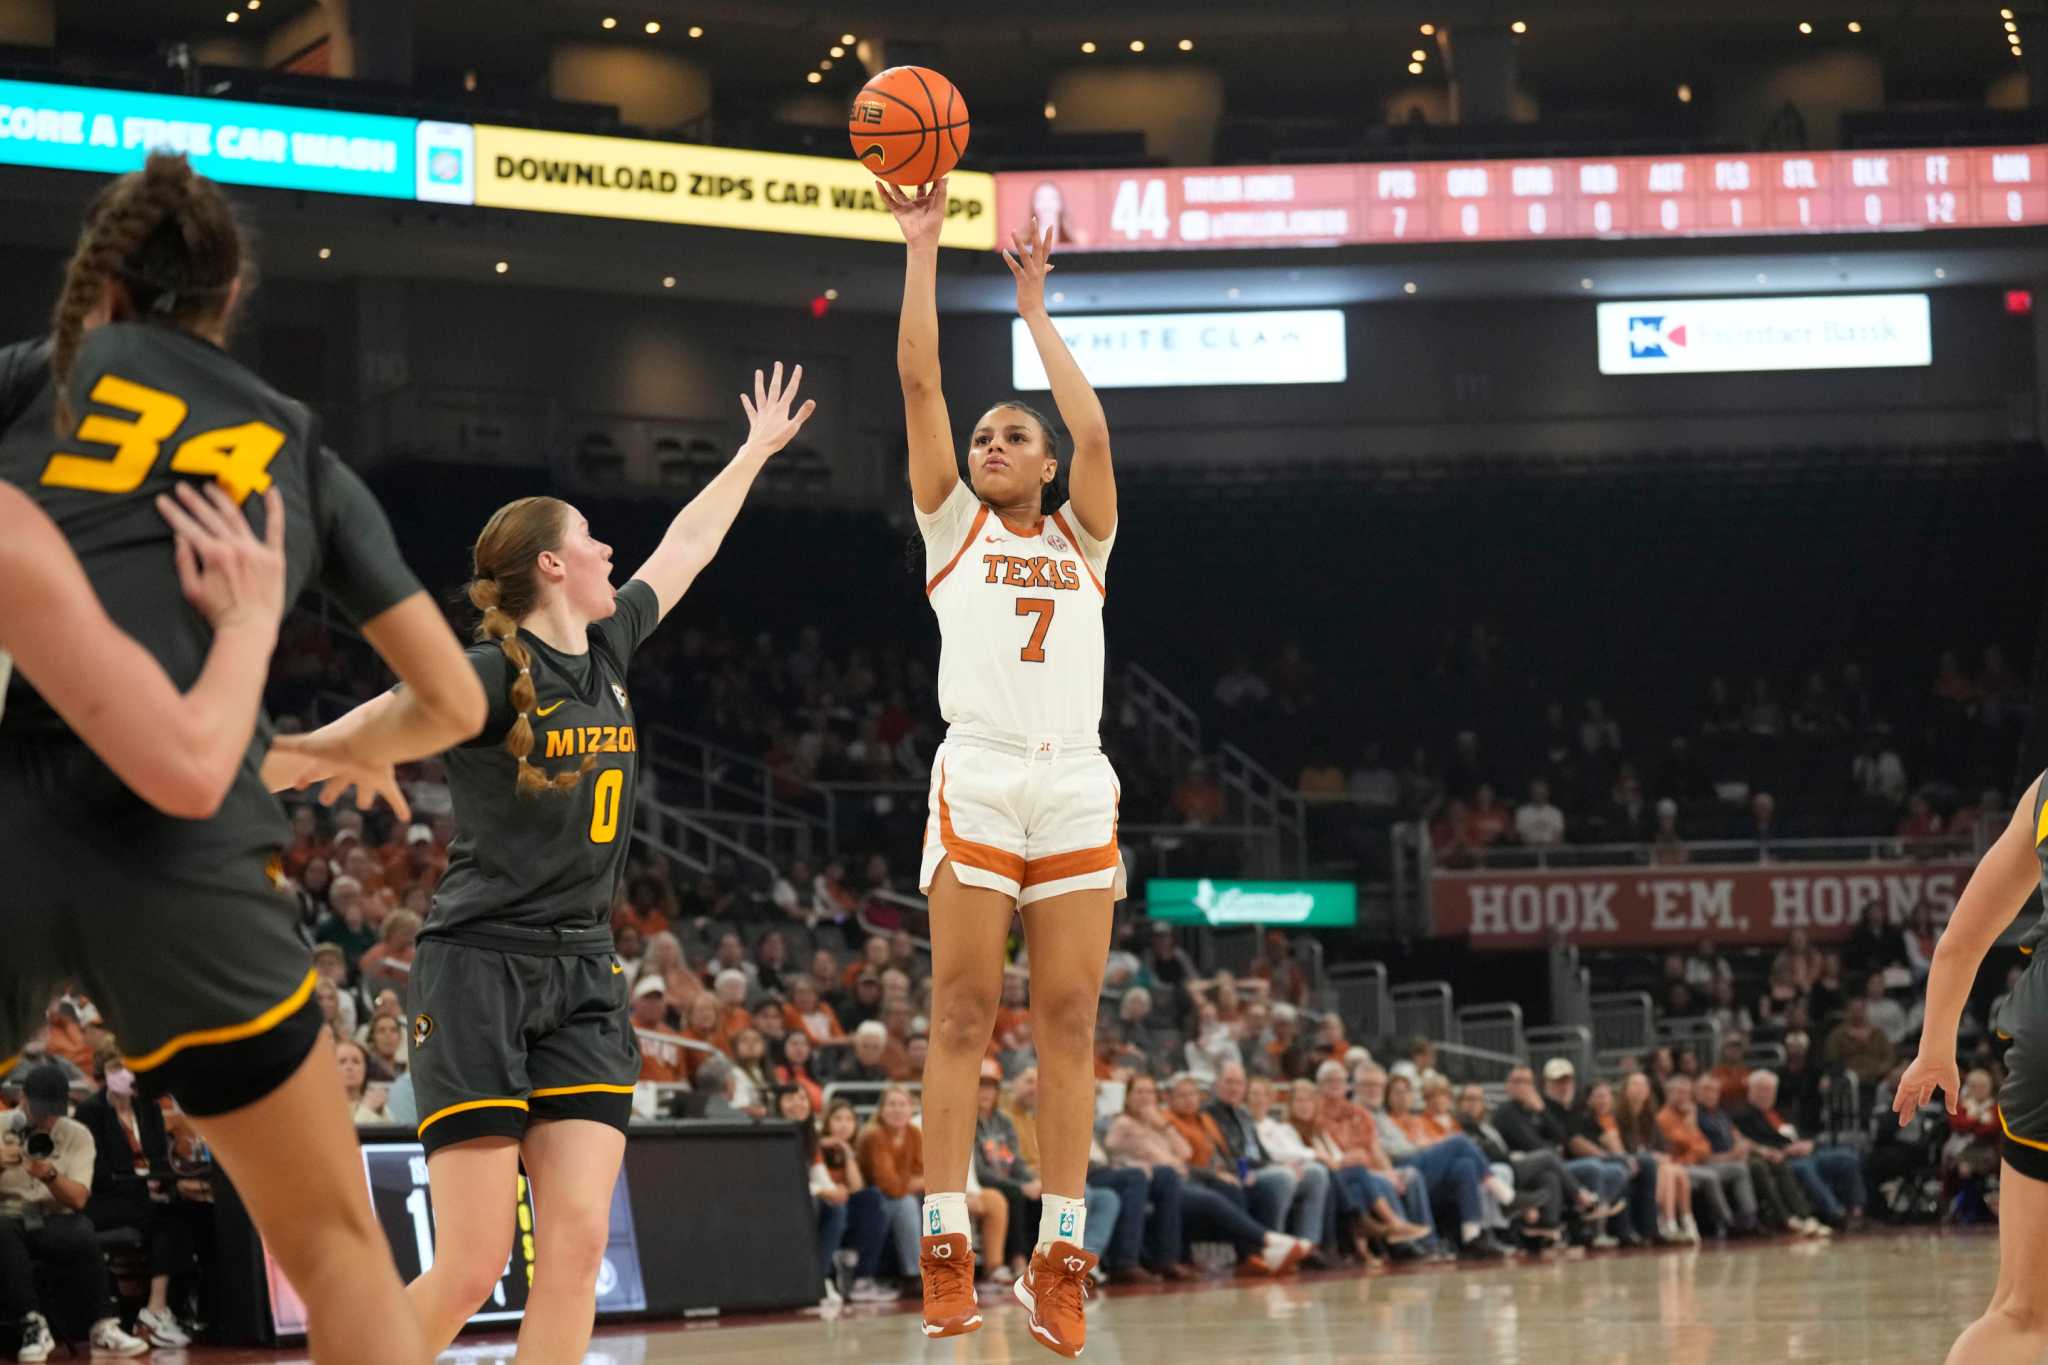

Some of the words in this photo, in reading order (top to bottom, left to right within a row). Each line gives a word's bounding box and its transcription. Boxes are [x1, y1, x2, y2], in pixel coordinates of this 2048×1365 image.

[89, 114, 117, 147] A
[216, 125, 287, 163] CAR
[292, 132, 396, 173] WASH
[1925, 155, 1948, 184] FT
[495, 155, 678, 193] DOWNLOAD
[689, 173, 755, 200] ZIPS
[764, 180, 820, 206] CAR
[831, 187, 882, 212] WA
[946, 198, 982, 220] PP
[1111, 180, 1170, 240] 44
[1393, 207, 1407, 237] 7
[1461, 204, 1479, 236] 0
[1528, 203, 1546, 234] 0
[1594, 201, 1611, 231] 0
[1661, 200, 1678, 230] 0
[1731, 199, 1742, 226] 1
[1799, 197, 1810, 225] 1
[1865, 194, 1881, 225] 0
[1064, 328, 1177, 351] WHITE
[39, 373, 287, 506] 34
[983, 554, 1080, 591] TEXAS
[1015, 597, 1055, 663] 7
[589, 767, 624, 845] 0
[1468, 881, 1620, 935] HOOK
[1769, 874, 1958, 929] HORNS
